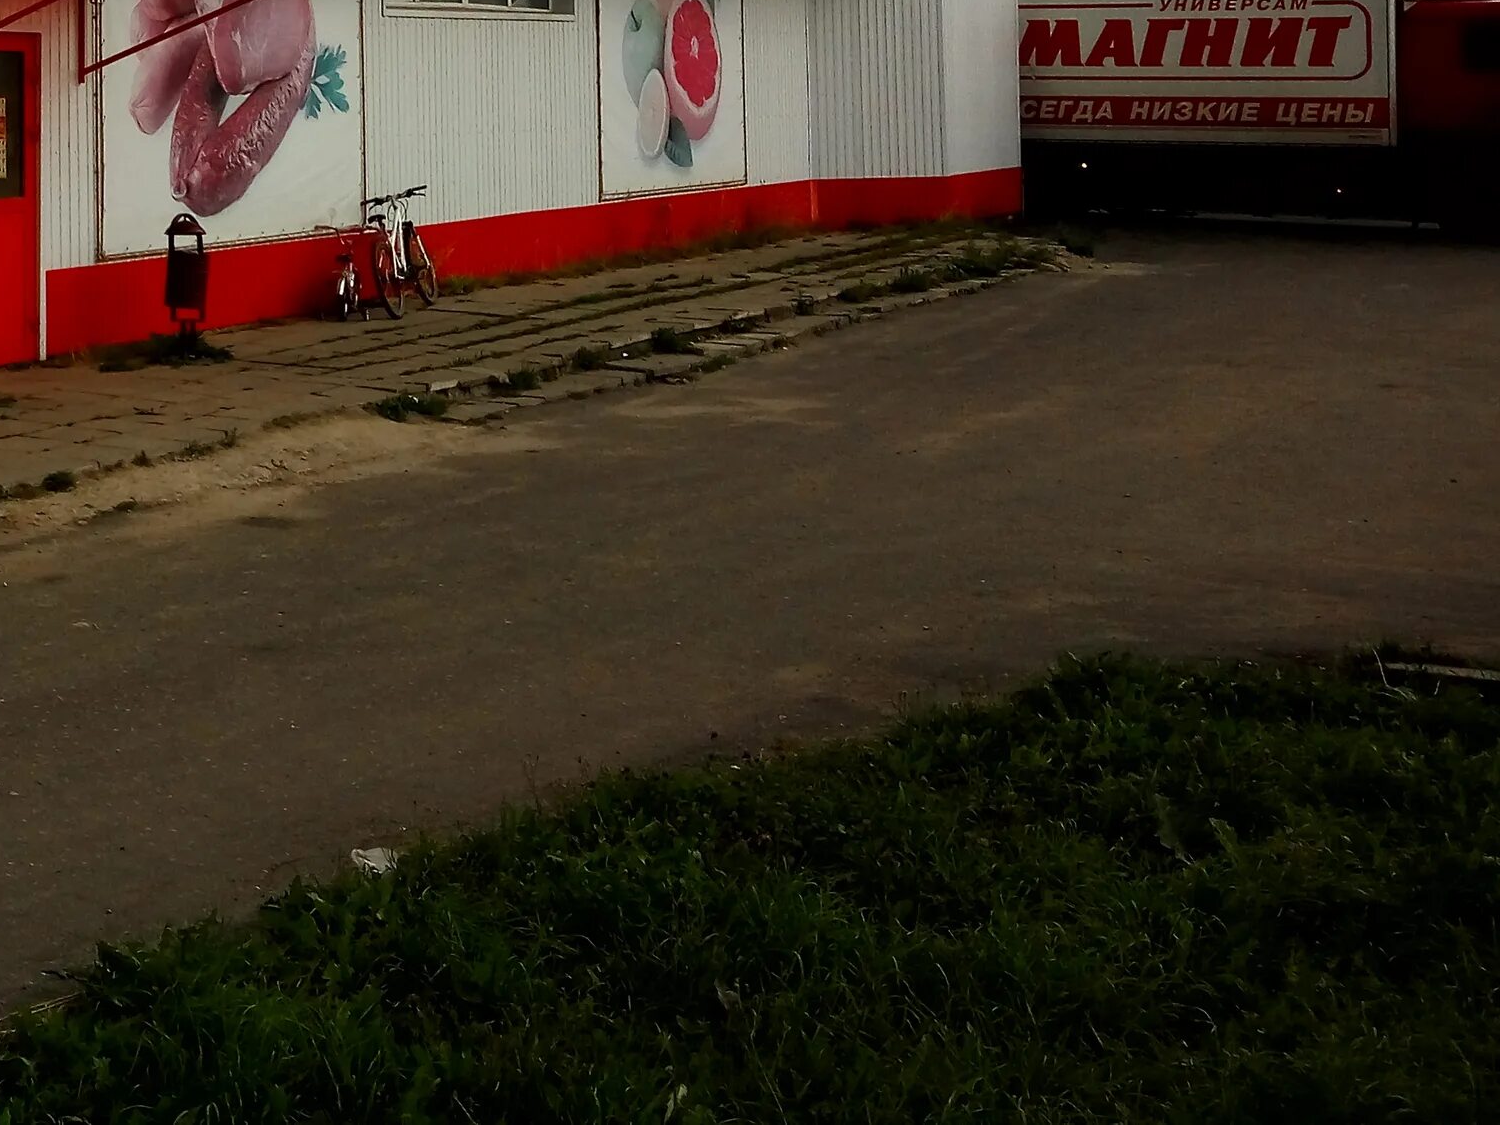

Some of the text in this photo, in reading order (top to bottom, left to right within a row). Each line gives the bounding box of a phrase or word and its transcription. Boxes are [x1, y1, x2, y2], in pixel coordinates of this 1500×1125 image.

[1019, 15, 1353, 68] МАГНИТ
[1020, 100, 1375, 125] СЕГДА НИЗКИЕ ЦЕНЫ
